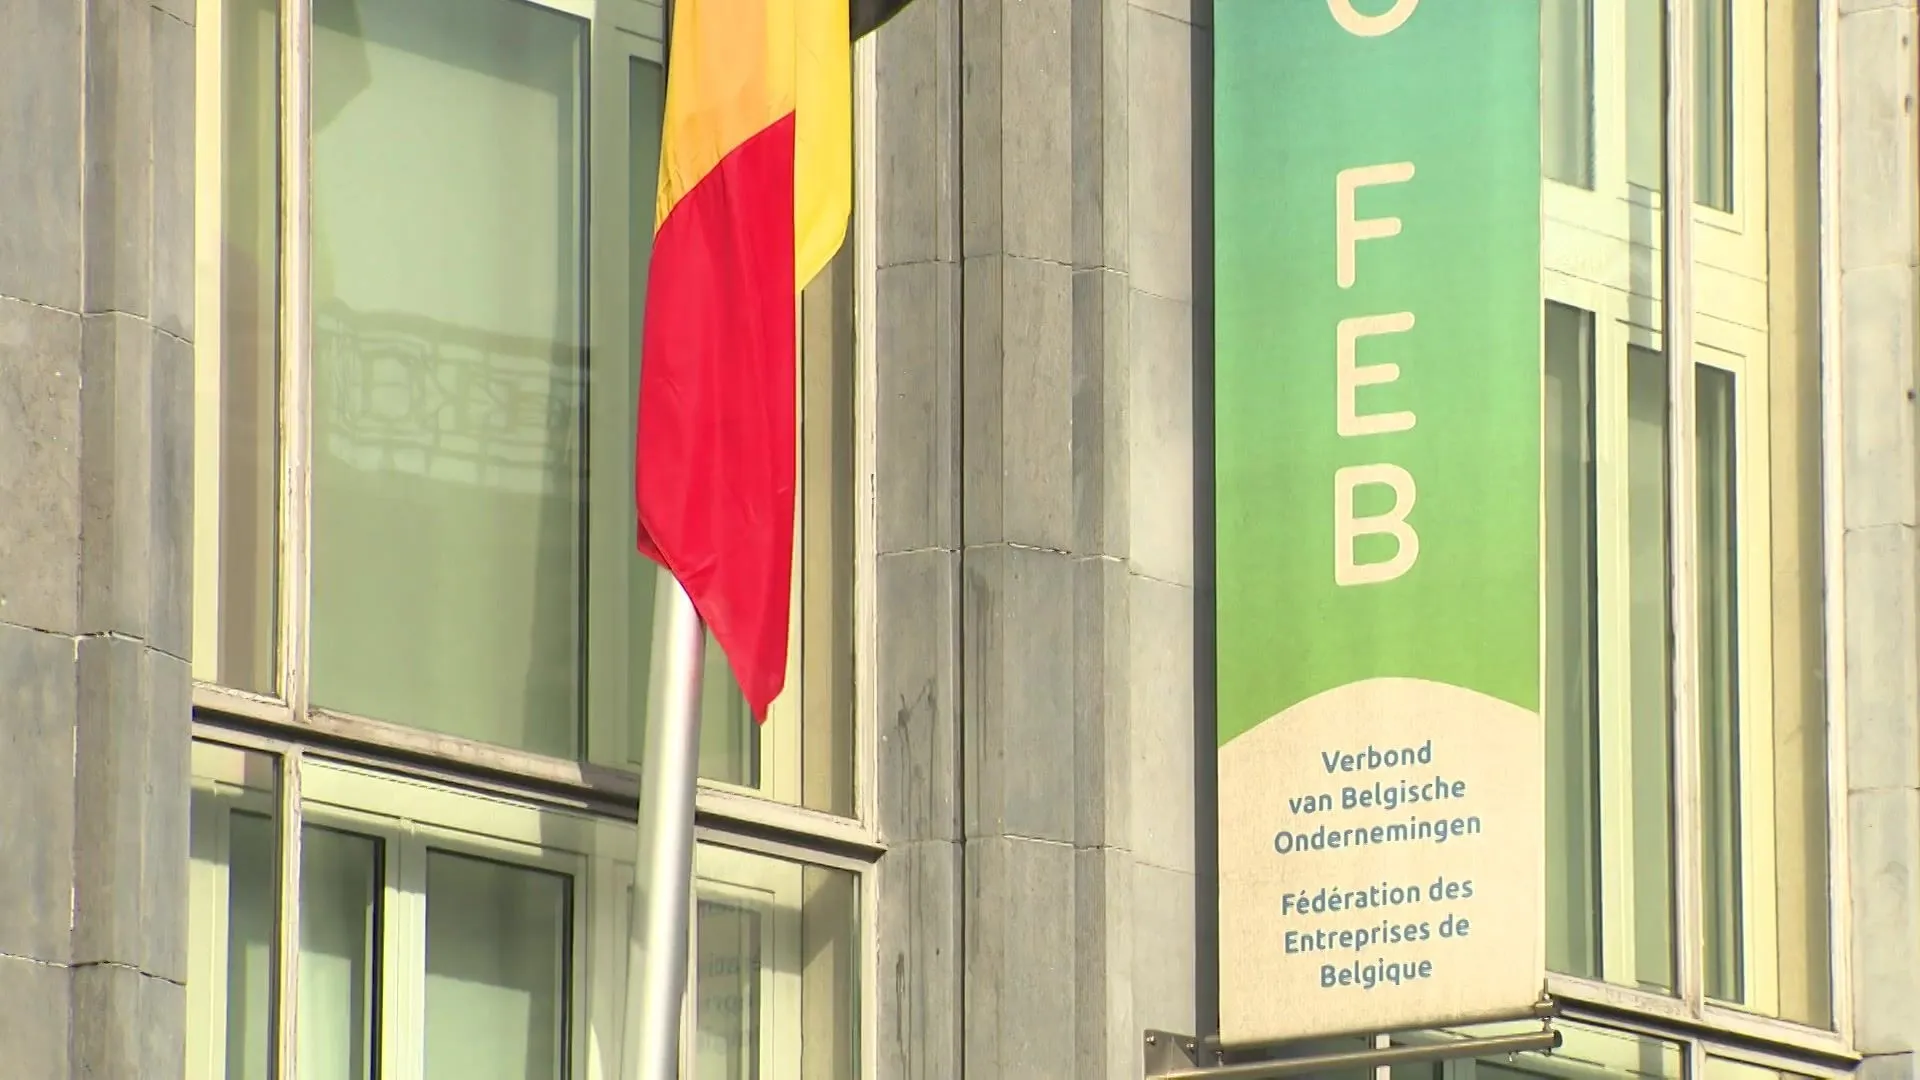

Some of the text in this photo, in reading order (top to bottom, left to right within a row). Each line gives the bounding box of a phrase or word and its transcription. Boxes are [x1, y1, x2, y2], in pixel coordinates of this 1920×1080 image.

[1335, 161, 1419, 586] FEB
[1321, 739, 1432, 774] Verbond
[1288, 775, 1466, 815] van Belgische
[1274, 815, 1481, 855] Ondernemingen
[1282, 876, 1473, 916] Fédération des
[1284, 913, 1470, 954] Entreprises de
[1320, 957, 1433, 990] Belgique
